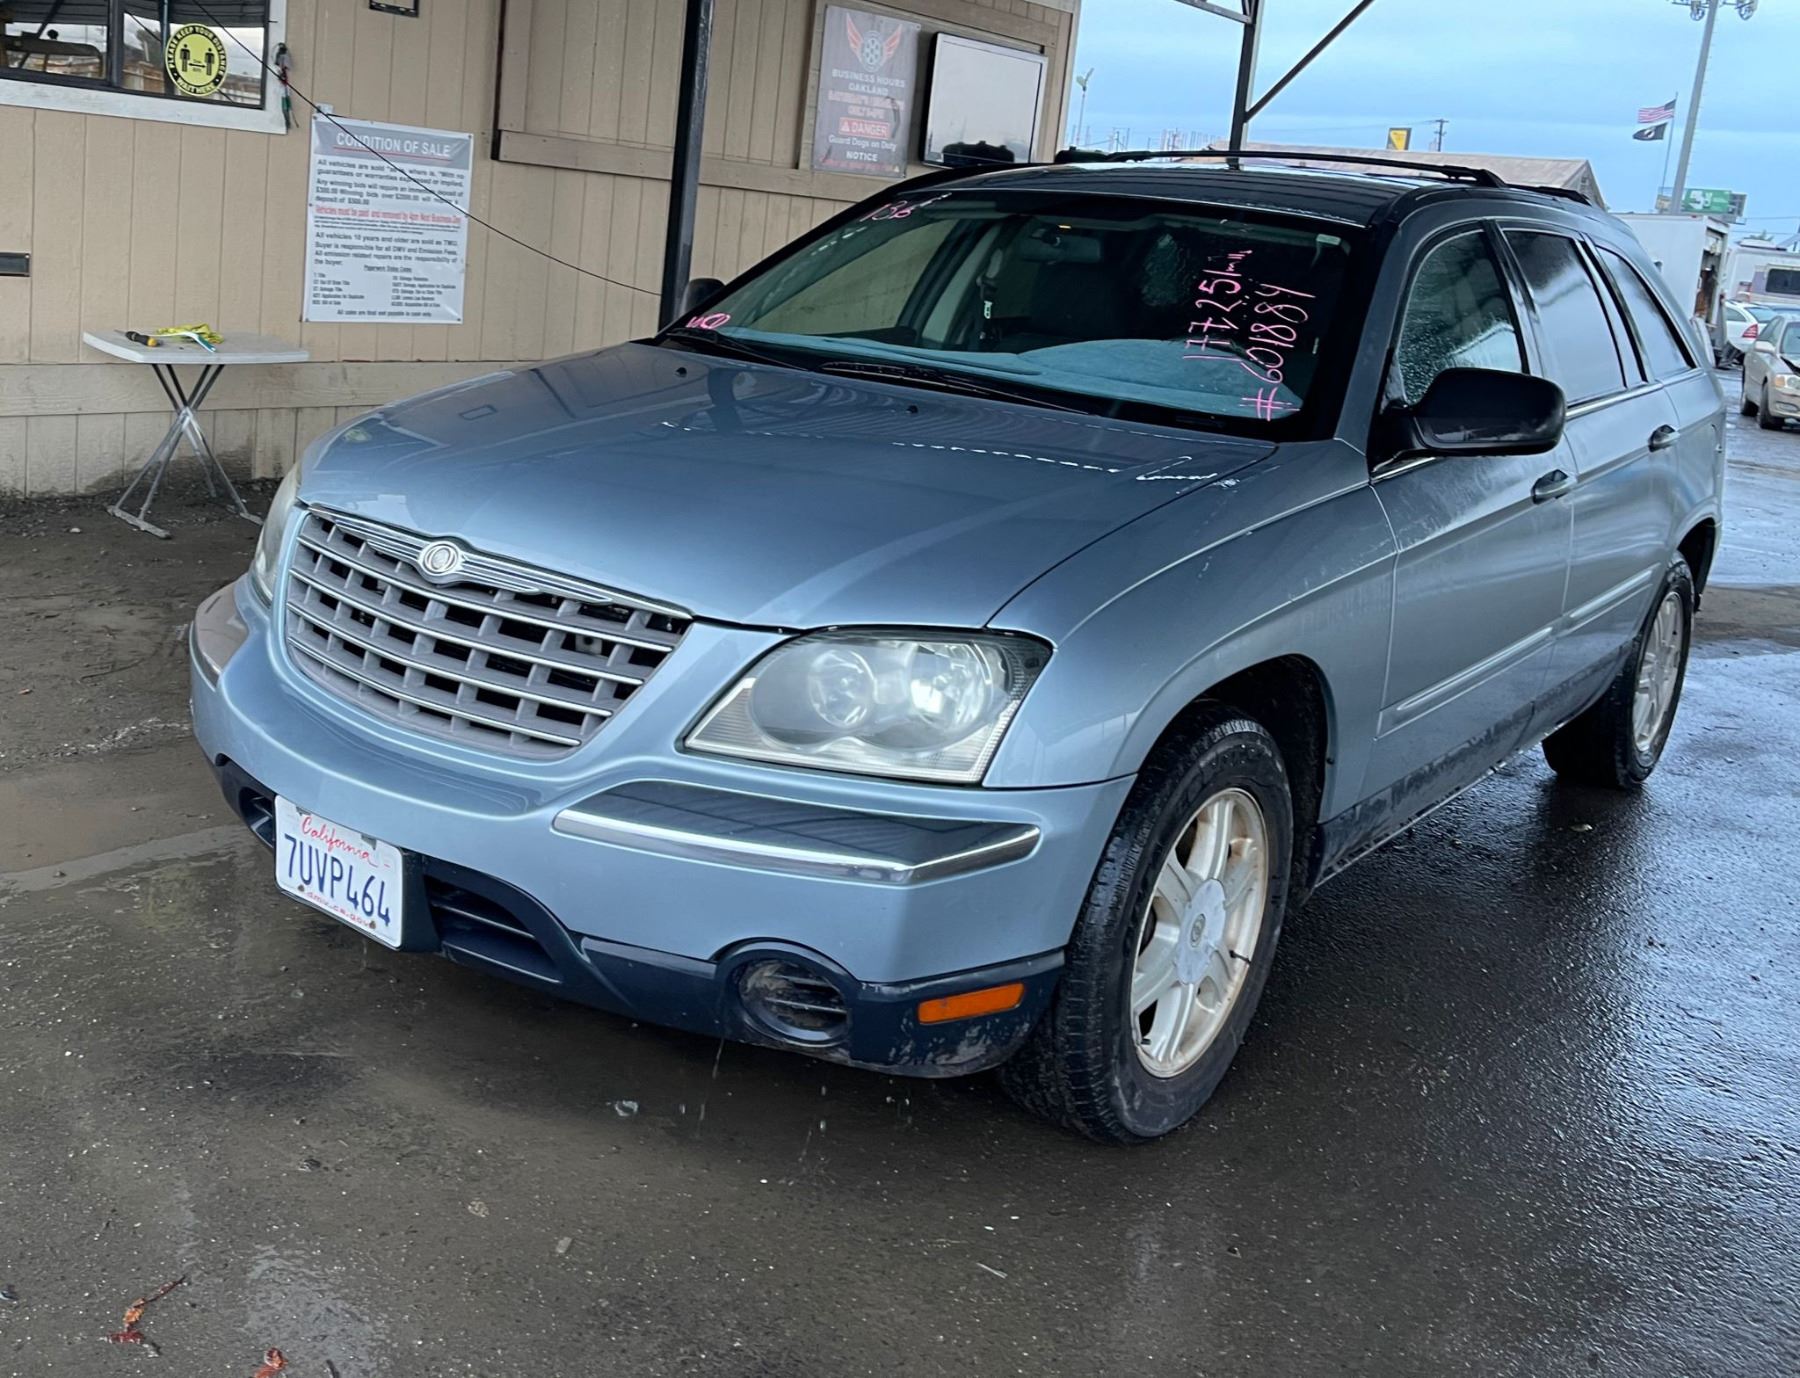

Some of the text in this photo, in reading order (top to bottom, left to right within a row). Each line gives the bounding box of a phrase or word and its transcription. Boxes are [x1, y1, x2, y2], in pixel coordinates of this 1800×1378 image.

[832, 68, 905, 88] BUSINESS HOURS
[848, 82, 888, 96] OAKLAND
[851, 121, 887, 137] DANGER
[336, 132, 451, 156] CONDITION OF SALE
[828, 134, 851, 144] Guard
[852, 137, 870, 149] Dogs
[881, 140, 897, 152] Duty
[846, 150, 878, 162] NOTICE
[301, 814, 379, 868] California
[284, 833, 391, 927] 7UVP464
